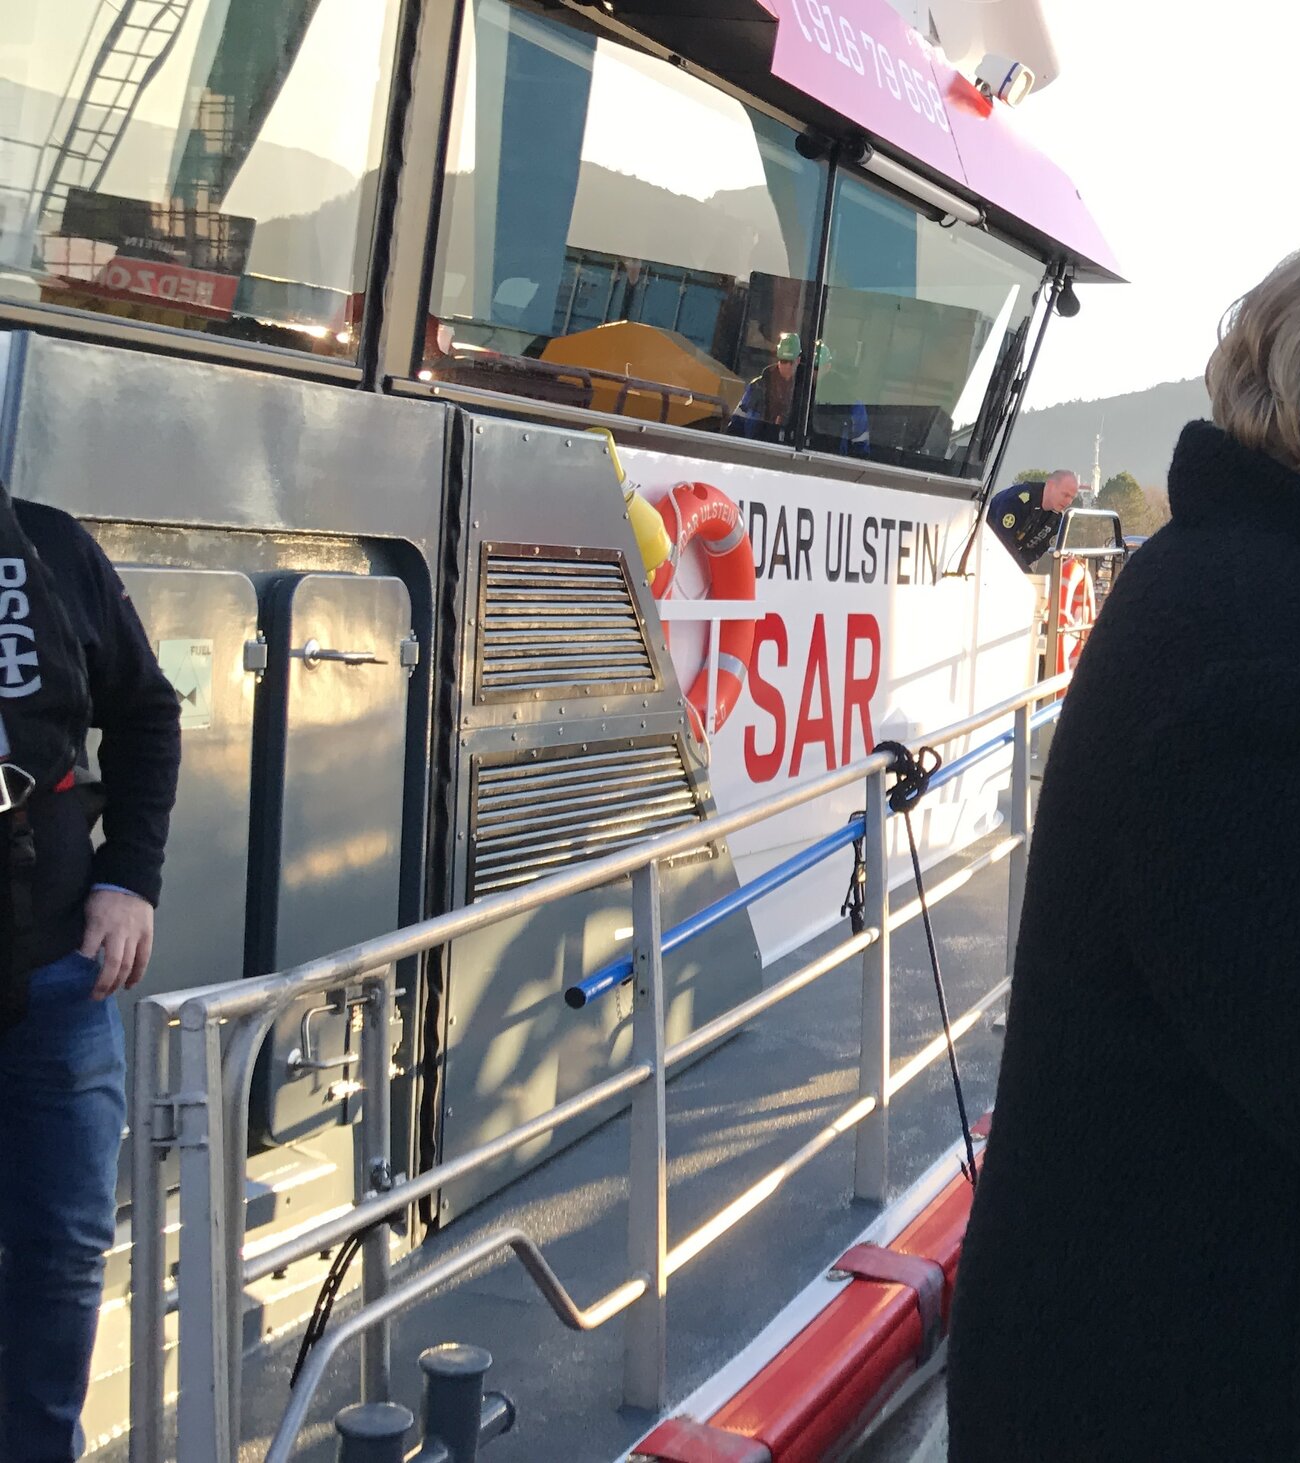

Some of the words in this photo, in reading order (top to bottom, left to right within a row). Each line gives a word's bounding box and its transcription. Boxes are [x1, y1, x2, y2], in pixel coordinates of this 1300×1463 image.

[806, 0, 864, 76] 916
[859, 30, 900, 101] 79
[898, 58, 950, 132] 658
[738, 500, 813, 581] DAR
[825, 510, 939, 586] ULSTEIN
[190, 645, 212, 656] FUEL
[744, 612, 881, 783] SAR
